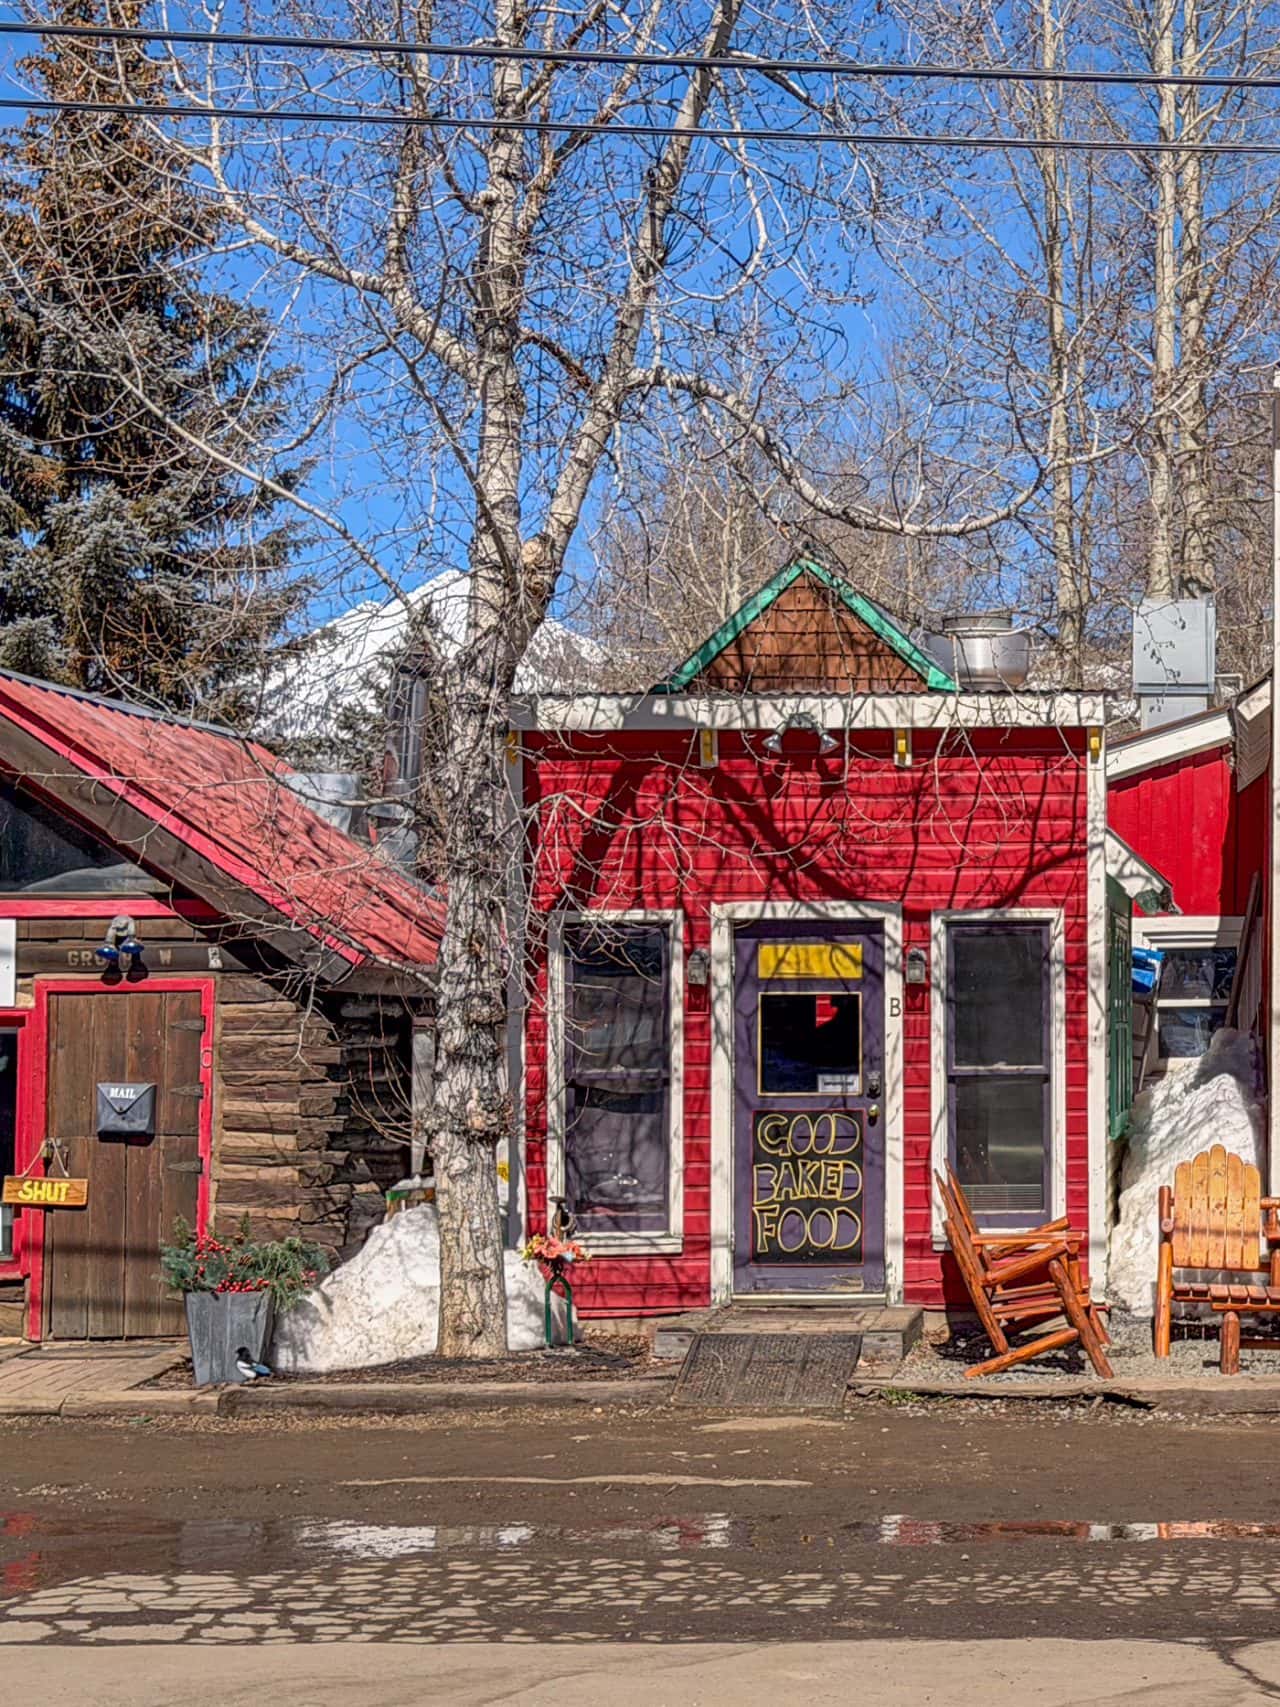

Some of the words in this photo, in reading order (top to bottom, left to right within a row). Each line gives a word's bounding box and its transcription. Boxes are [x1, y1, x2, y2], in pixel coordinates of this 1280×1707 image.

[889, 997, 902, 1017] B
[110, 1087, 136, 1099] MAIL
[757, 1113, 860, 1157] GOOD
[18, 1180, 70, 1202] SHUT
[753, 1159, 862, 1205] BAKED
[752, 1204, 862, 1253] FOOD
